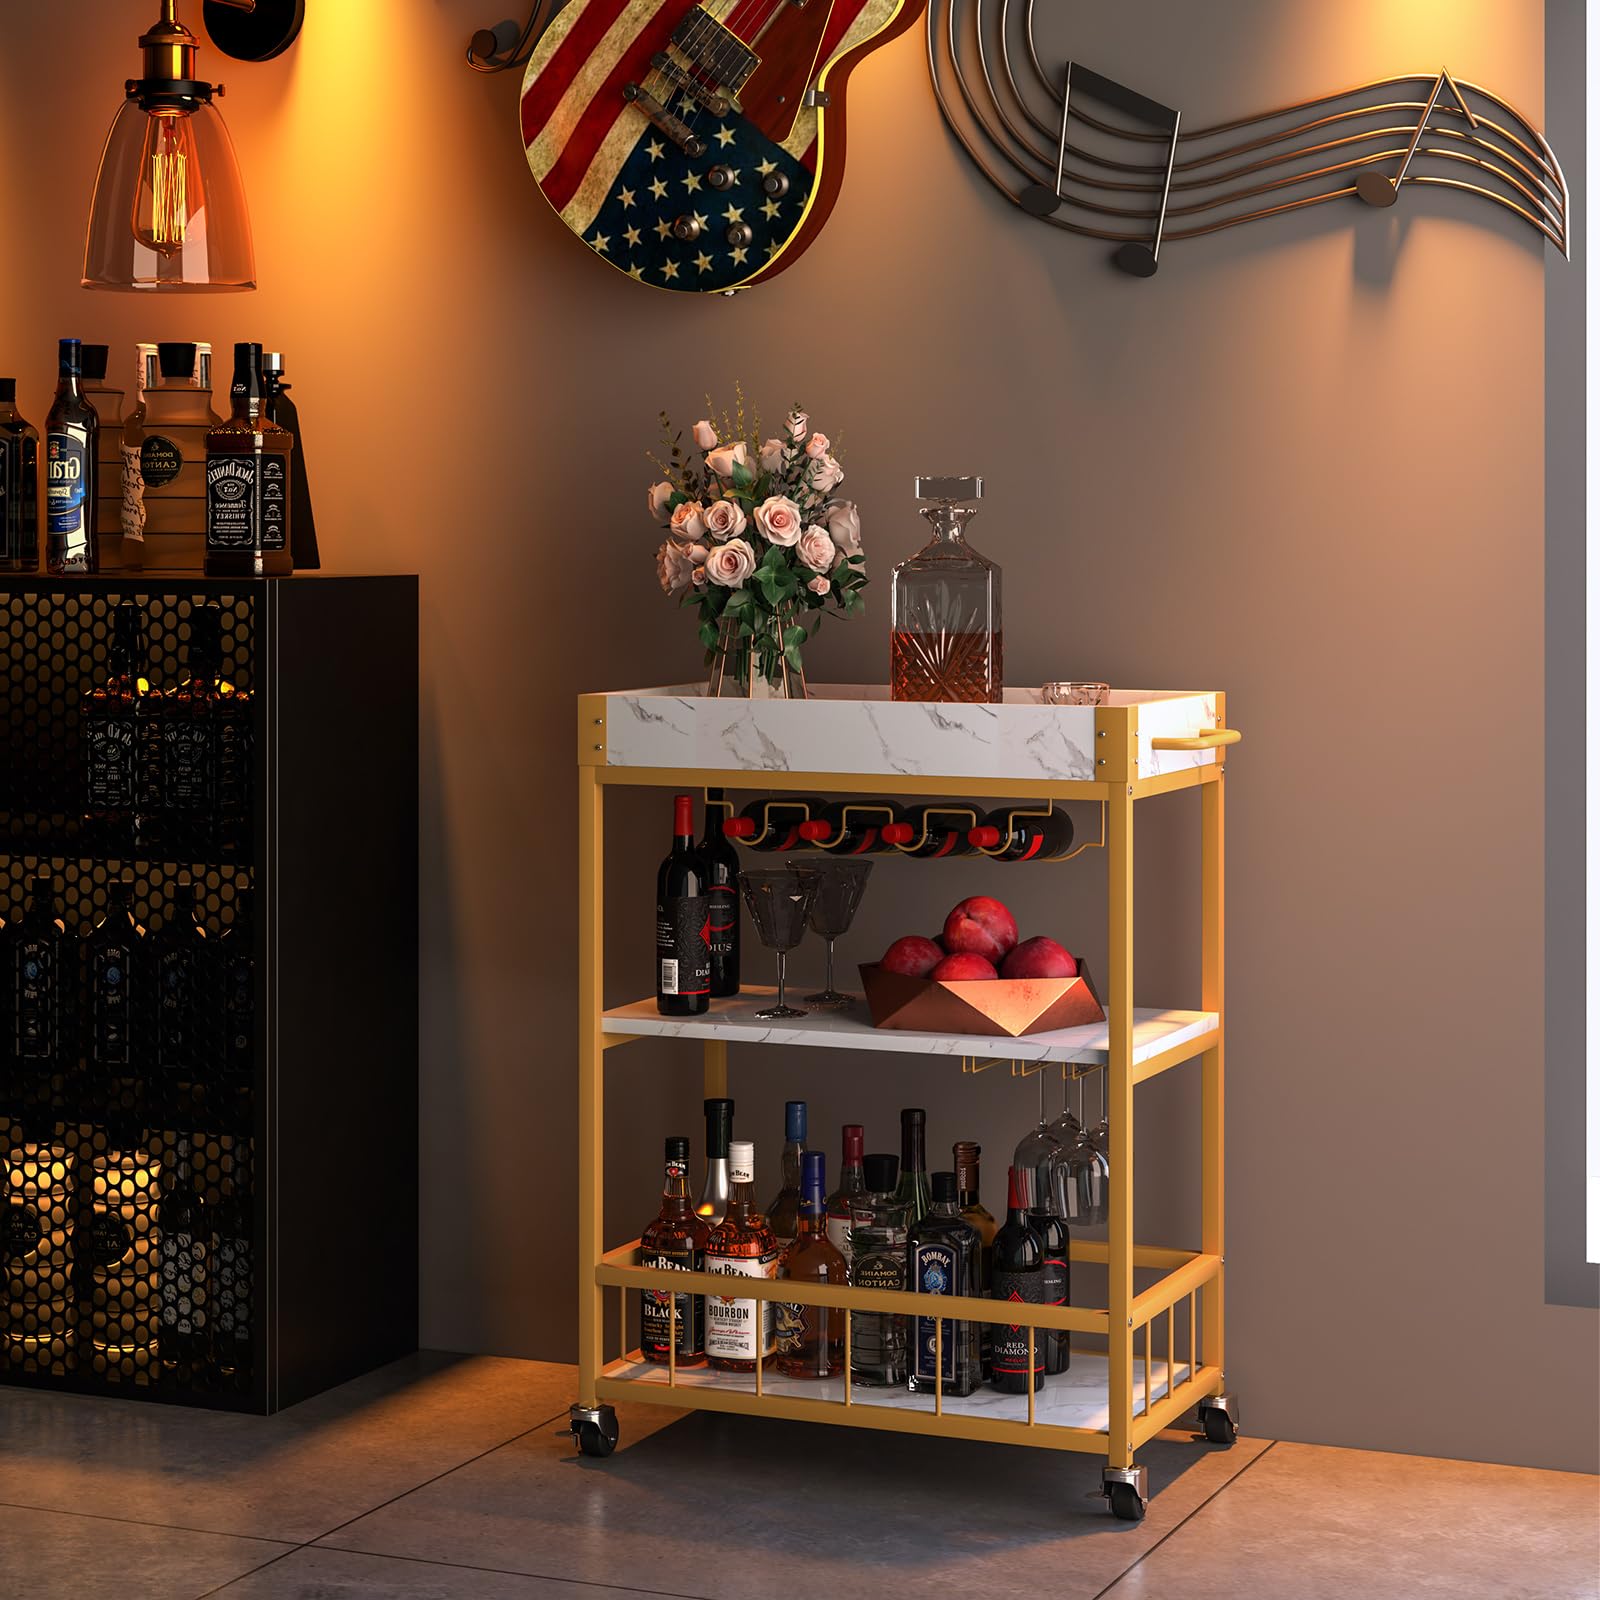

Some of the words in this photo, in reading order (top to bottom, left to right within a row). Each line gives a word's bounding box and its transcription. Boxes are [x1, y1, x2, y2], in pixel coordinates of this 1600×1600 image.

[921, 1251, 951, 1267] BOMBAY
[708, 1305, 749, 1319] BOURBON
[994, 1345, 1038, 1355] DIAMOND
